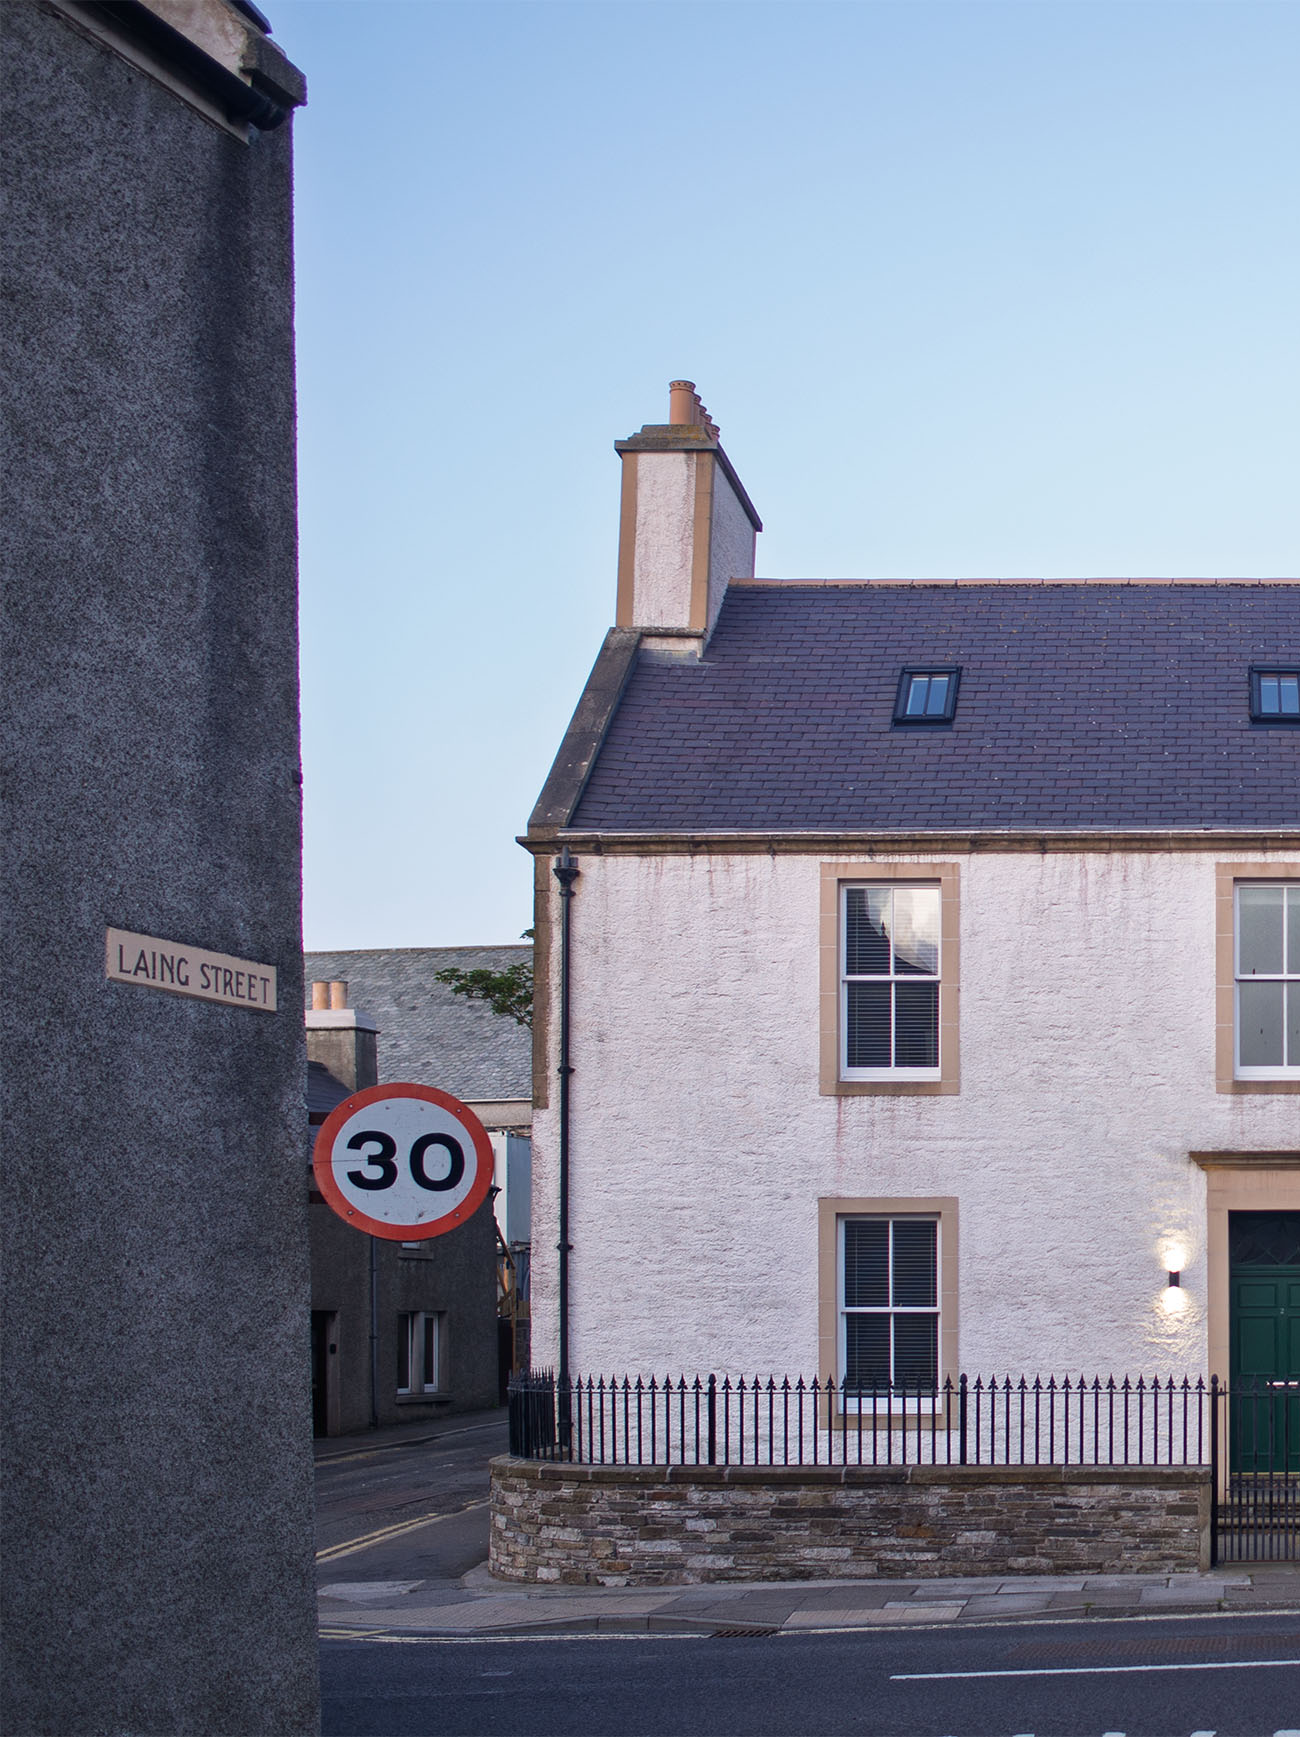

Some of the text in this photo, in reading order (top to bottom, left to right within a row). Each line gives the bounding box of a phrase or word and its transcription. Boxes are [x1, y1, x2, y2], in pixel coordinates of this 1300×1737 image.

[118, 944, 271, 1004] LAING STREET
[347, 1130, 465, 1192] 30
